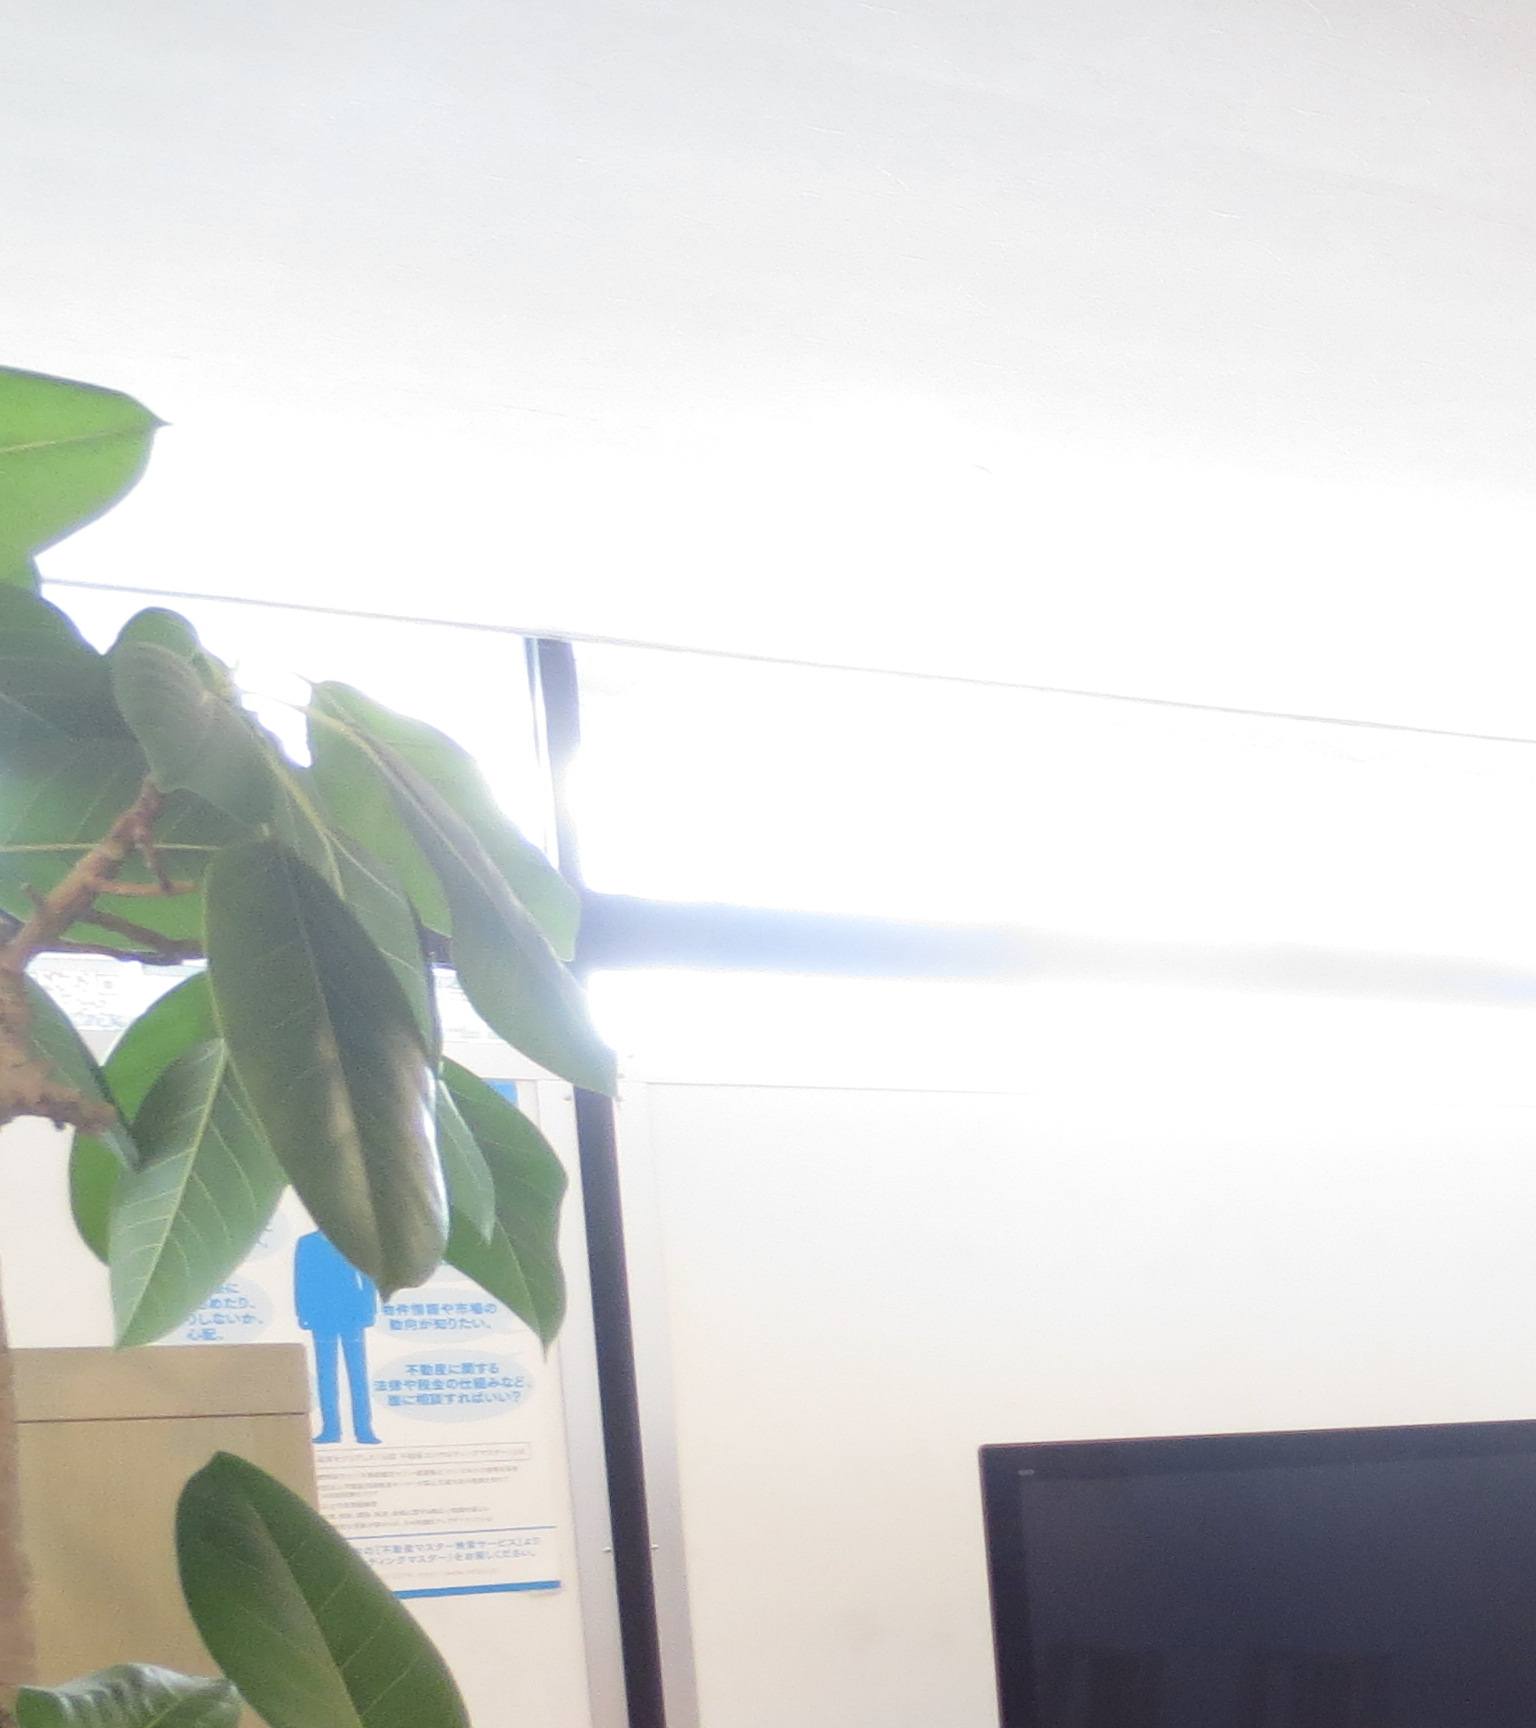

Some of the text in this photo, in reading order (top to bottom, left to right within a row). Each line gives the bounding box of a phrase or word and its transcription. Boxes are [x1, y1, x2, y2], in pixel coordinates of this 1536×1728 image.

[390, 1319, 491, 1331] 動向が知りたい。
[405, 1362, 500, 1375] 不動産に関する
